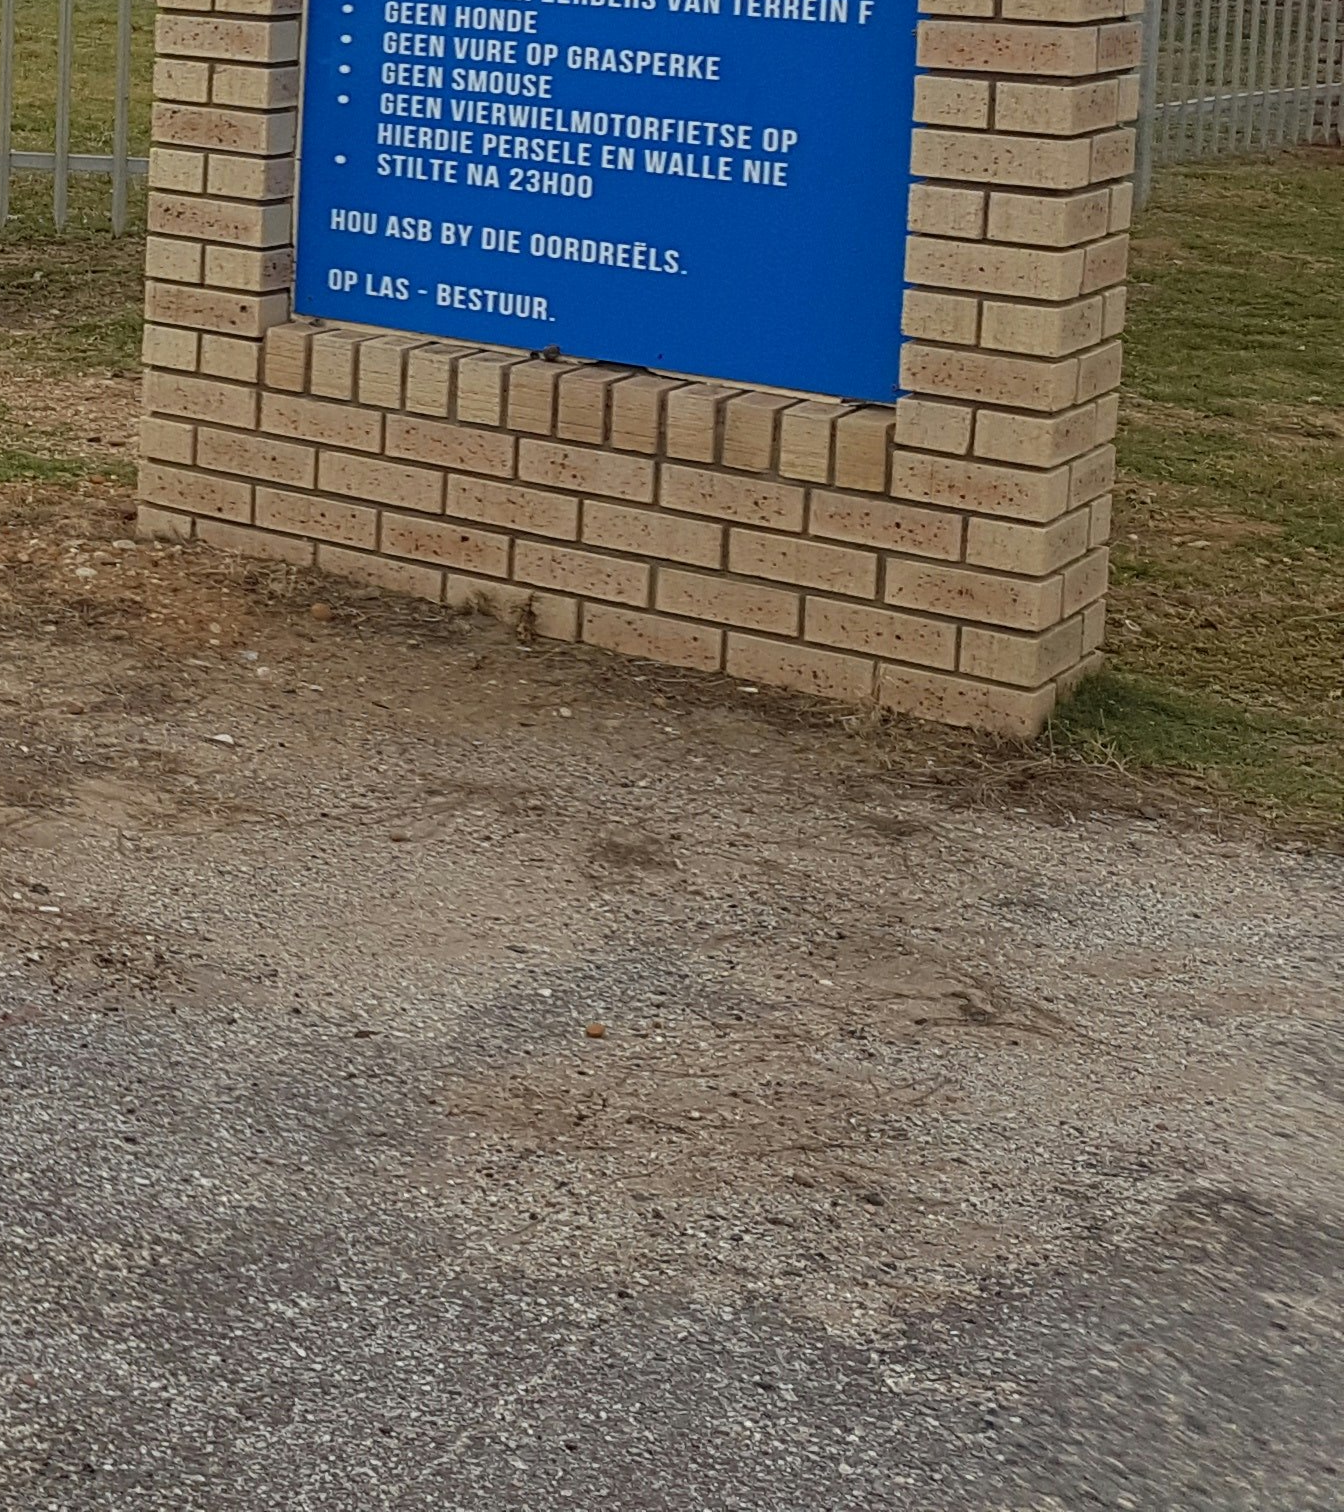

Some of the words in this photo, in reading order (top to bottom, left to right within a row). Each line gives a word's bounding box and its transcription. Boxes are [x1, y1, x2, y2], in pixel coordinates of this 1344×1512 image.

[384, 0, 447, 27] GEEN
[455, 5, 538, 34] HONDE
[858, 0, 875, 25] F
[382, 62, 443, 89] GEEN
[451, 68, 553, 99] SMOUSE
[383, 31, 445, 58] GEEN
[453, 37, 518, 64] VURE
[526, 42, 558, 67] OP
[567, 45, 721, 81] GRASPERKE
[380, 92, 442, 120] GEEN
[450, 99, 753, 150] VIERWIELMOTORFIETSE
[763, 127, 798, 153] OP
[377, 123, 474, 154] HIERDIE
[482, 133, 592, 167] PERSELE
[601, 145, 635, 171] EN
[644, 149, 733, 181] WALLE
[743, 159, 788, 187] NIE
[377, 153, 458, 184] STILTE
[467, 163, 500, 188] NA
[330, 208, 378, 235] HOU
[385, 215, 432, 242] ASB
[441, 222, 473, 247] BY
[481, 227, 522, 254] DIE
[530, 233, 688, 275] OORDREËLS.
[328, 268, 358, 293] OP
[365, 273, 410, 300] LAS
[436, 283, 556, 322] BESTUUR.
